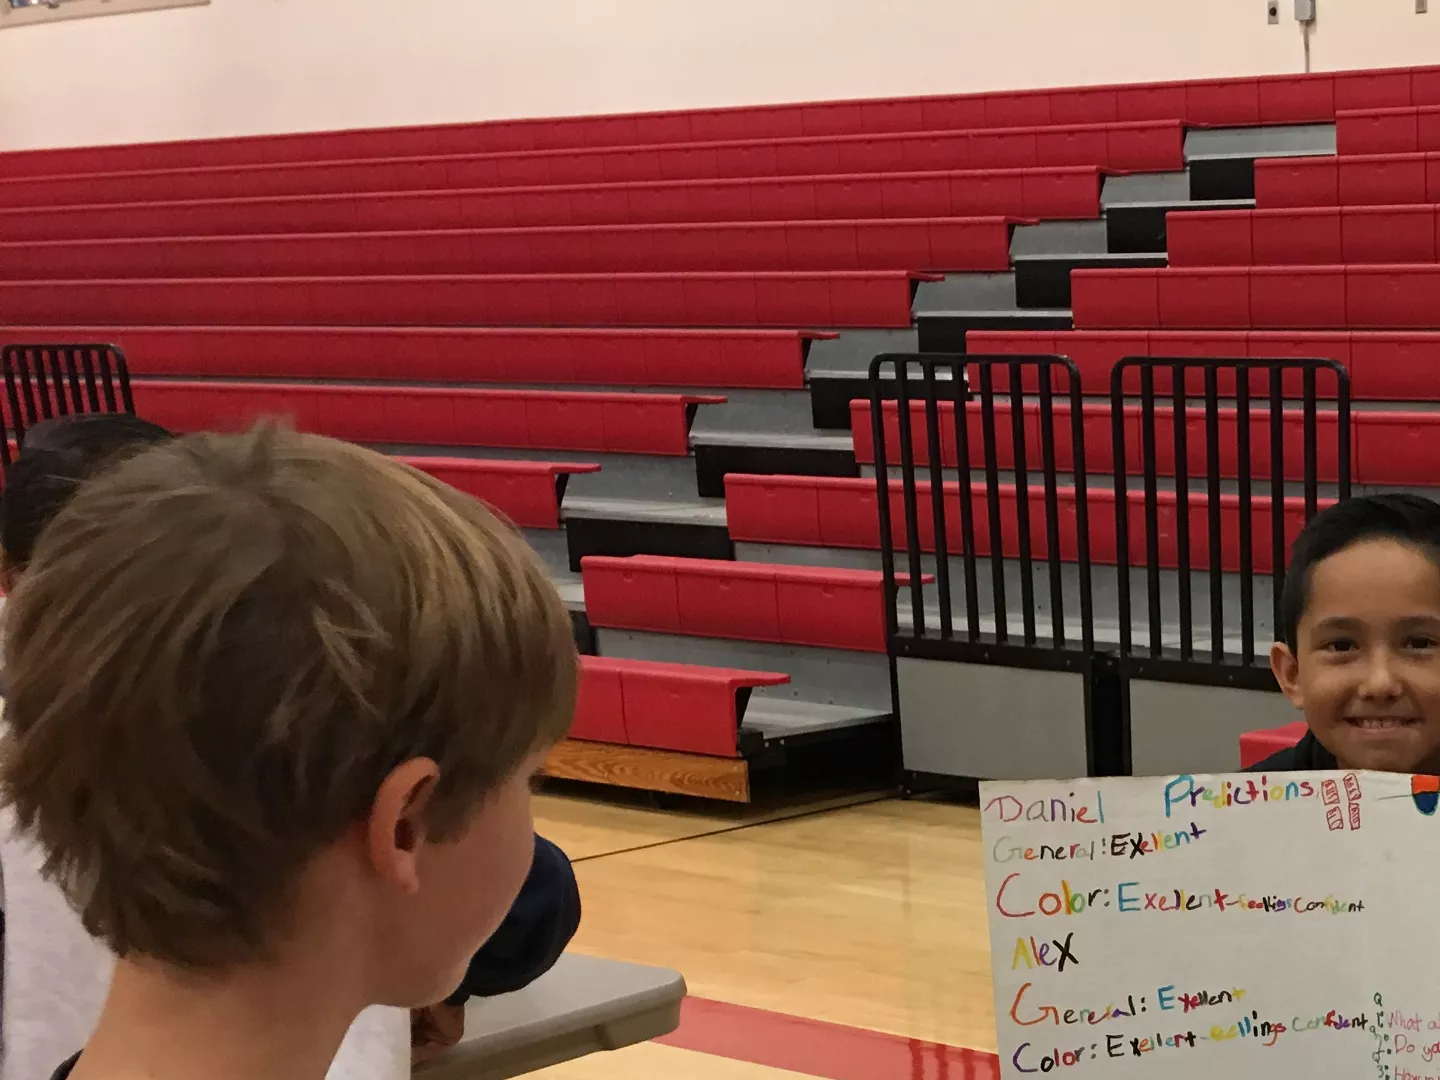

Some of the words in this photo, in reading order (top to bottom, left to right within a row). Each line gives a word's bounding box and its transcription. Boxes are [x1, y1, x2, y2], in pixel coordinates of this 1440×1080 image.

[985, 790, 1104, 823] Daniel
[996, 873, 1109, 918] Color:
[1387, 1009, 1422, 1032] What
[1013, 1042, 1097, 1073] Color:
[1394, 1034, 1415, 1054] Do
